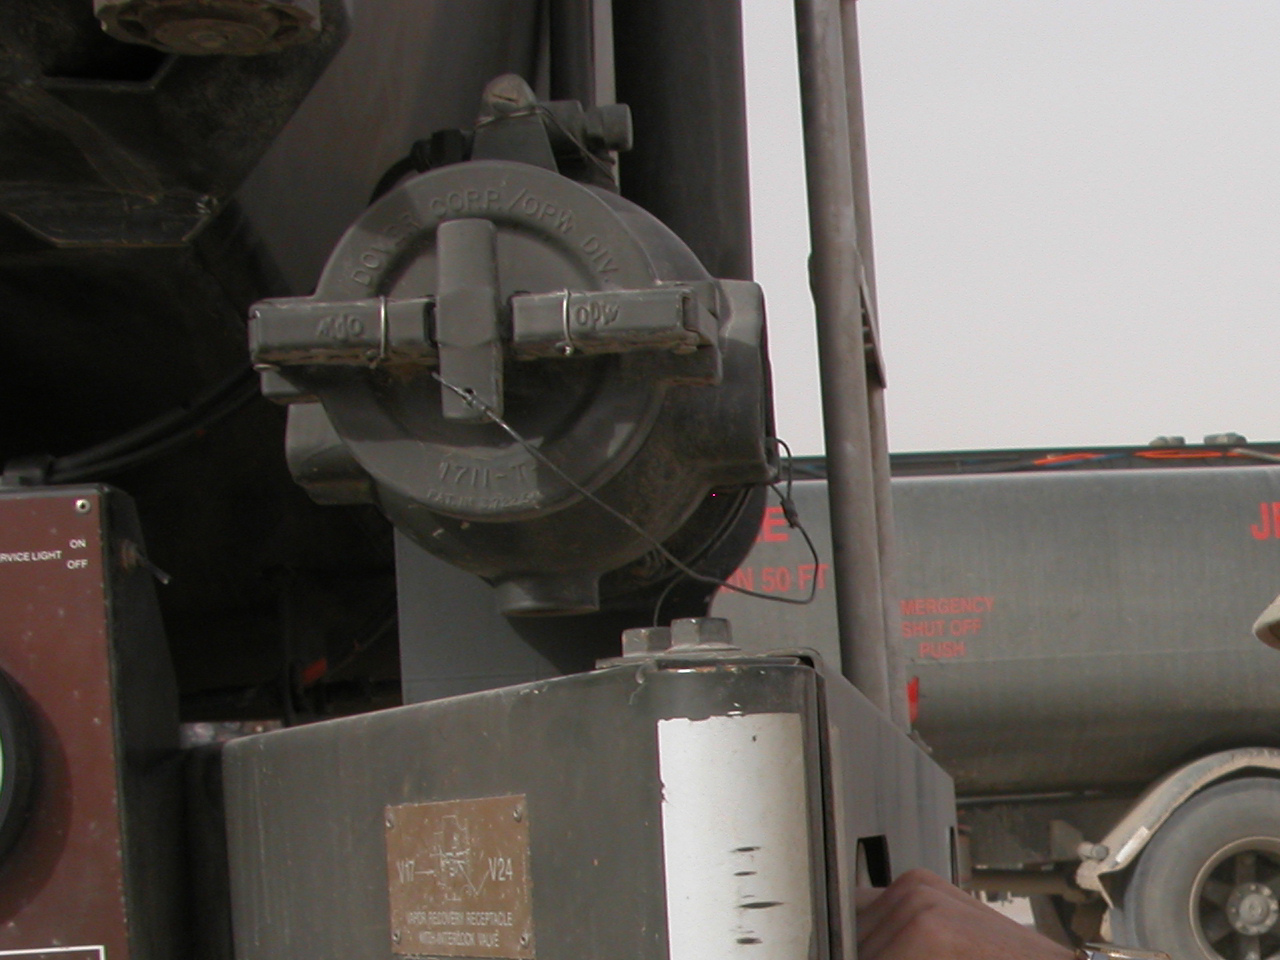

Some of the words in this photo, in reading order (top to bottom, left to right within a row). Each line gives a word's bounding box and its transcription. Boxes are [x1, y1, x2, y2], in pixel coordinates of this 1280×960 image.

[69, 539, 87, 550] ON
[31, 550, 63, 561] LIGHT
[66, 559, 89, 570] OFF
[761, 566, 789, 593] 50
[797, 564, 830, 590] FT
[901, 620, 946, 638] SHUT
[950, 618, 983, 637] OFF
[918, 640, 968, 659] PUSH
[487, 857, 513, 882] V24
